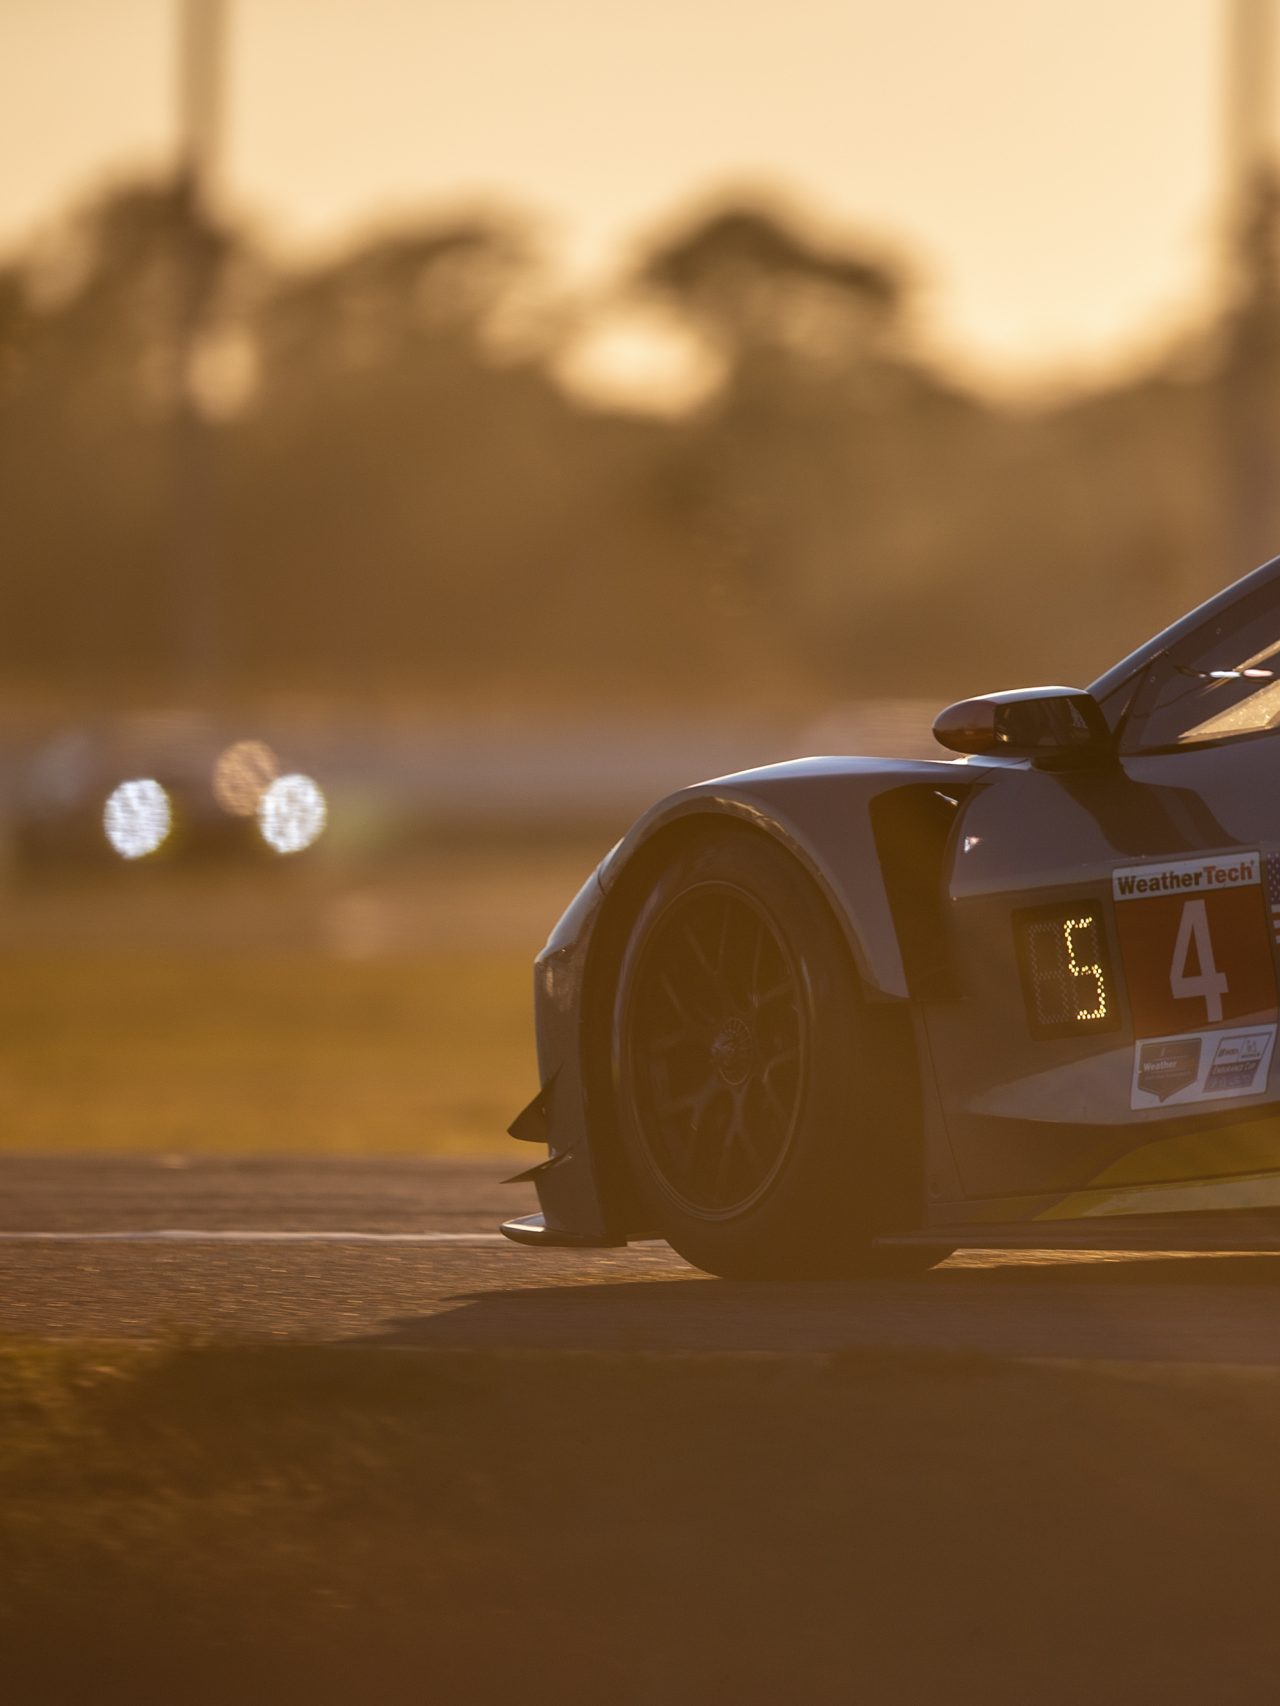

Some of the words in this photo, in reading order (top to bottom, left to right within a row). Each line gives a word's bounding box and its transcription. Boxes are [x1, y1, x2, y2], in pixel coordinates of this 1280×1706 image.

[1117, 859, 1254, 895] WeatherTech
[1064, 916, 1106, 1021] 5
[1169, 898, 1229, 1022] 4
